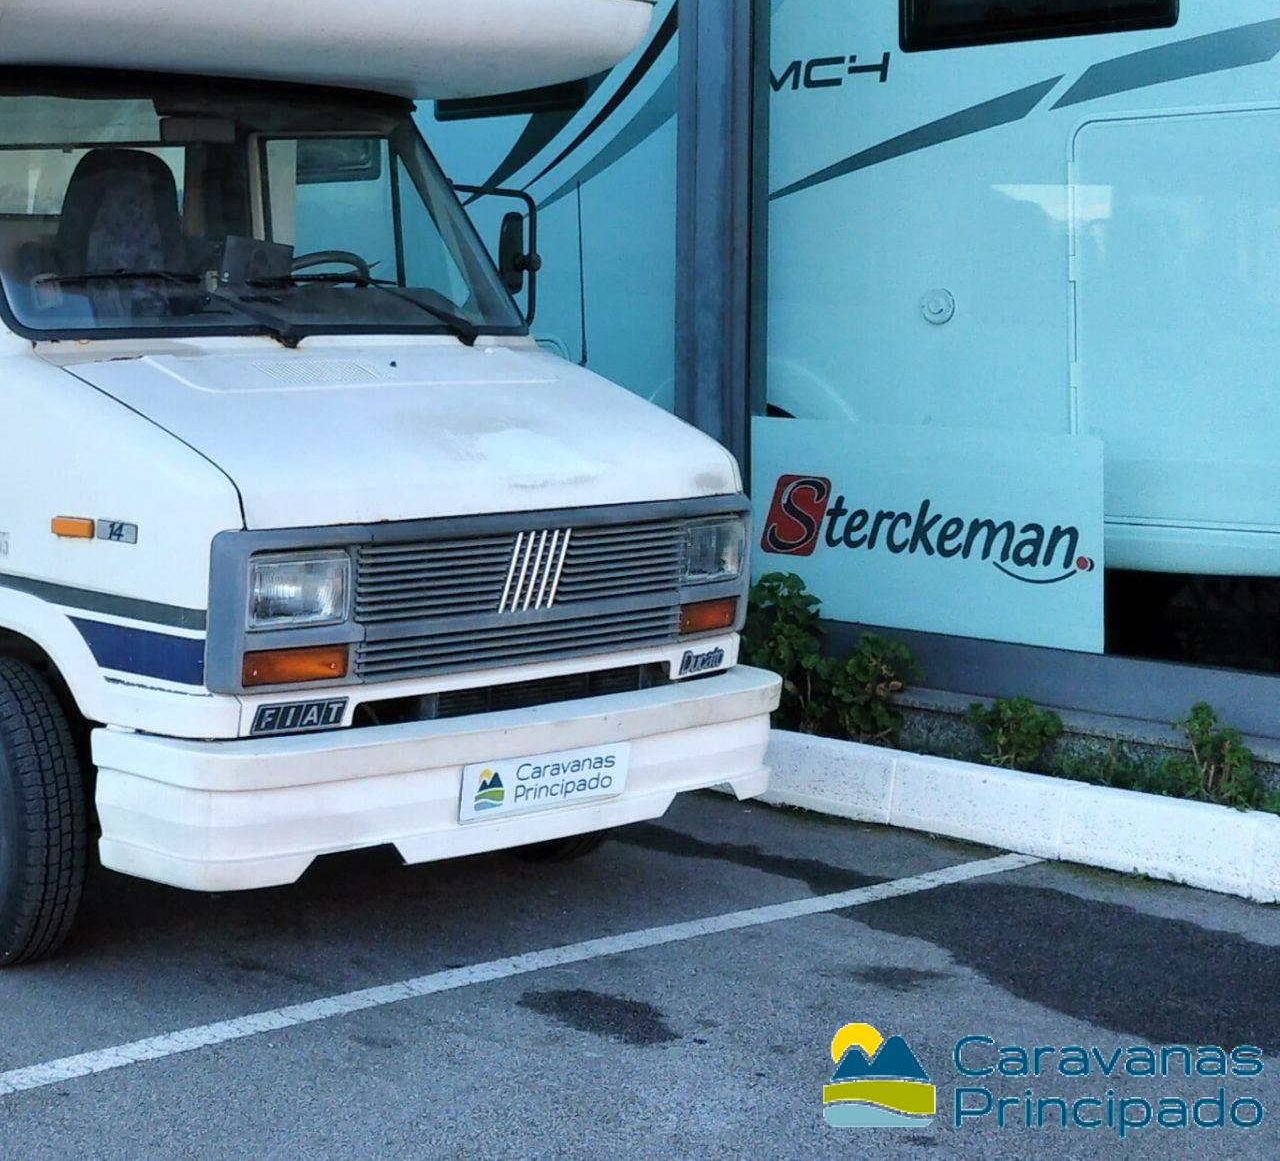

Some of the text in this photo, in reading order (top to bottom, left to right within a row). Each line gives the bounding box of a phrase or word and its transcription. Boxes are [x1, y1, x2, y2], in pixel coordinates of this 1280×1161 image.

[109, 522, 124, 541] 14
[679, 646, 725, 675] Ducato
[260, 703, 344, 729] FIAT
[515, 754, 616, 781] Caravanas
[513, 772, 612, 803] Principado
